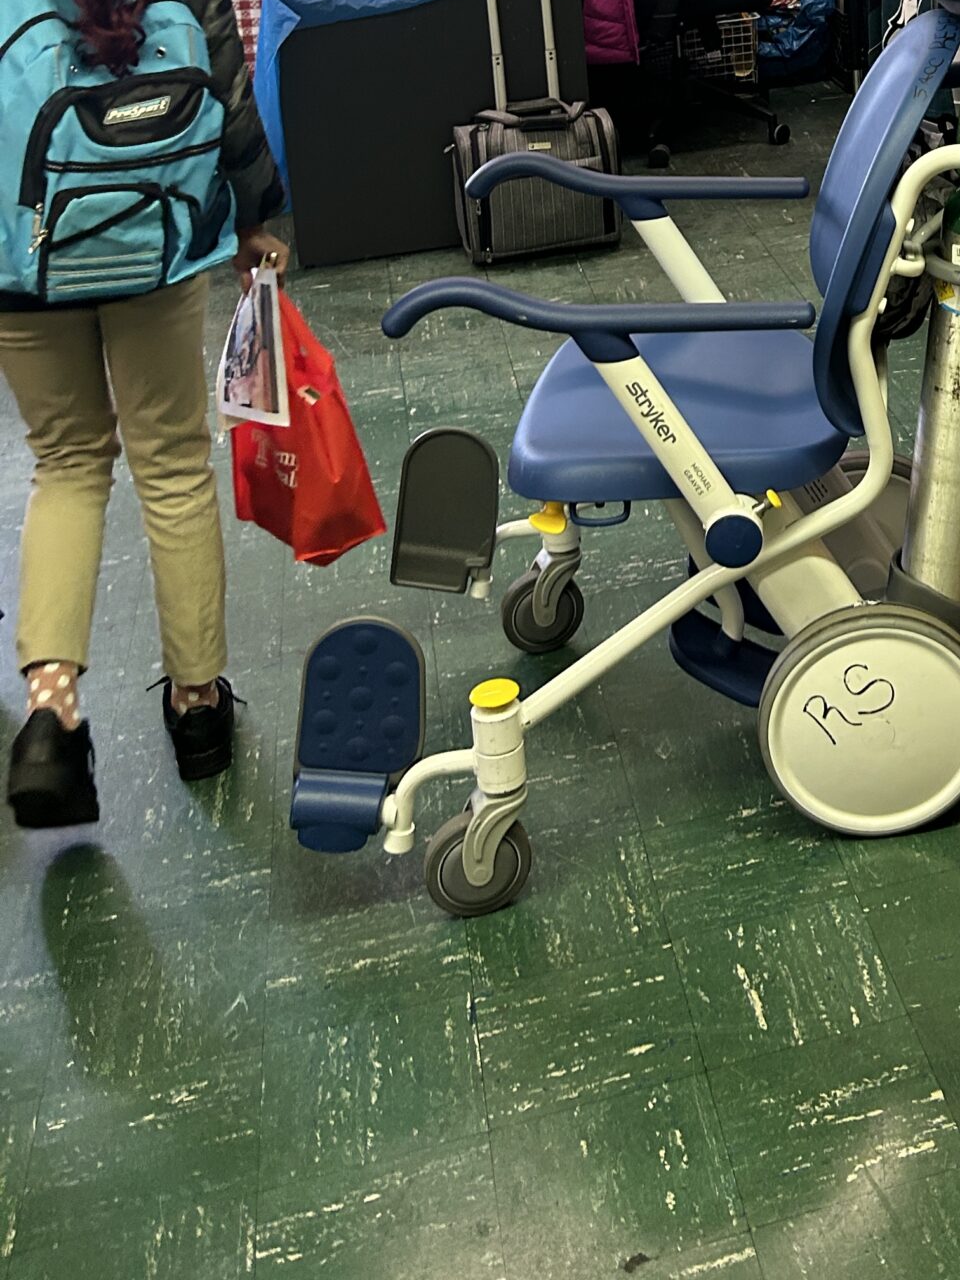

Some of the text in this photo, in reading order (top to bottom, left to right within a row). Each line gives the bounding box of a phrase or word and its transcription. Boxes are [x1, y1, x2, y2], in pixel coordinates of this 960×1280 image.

[625, 381, 677, 444] stryker
[683, 469, 705, 496] GRAVES
[691, 462, 712, 492] MICHAEL
[803, 664, 895, 745] RS
